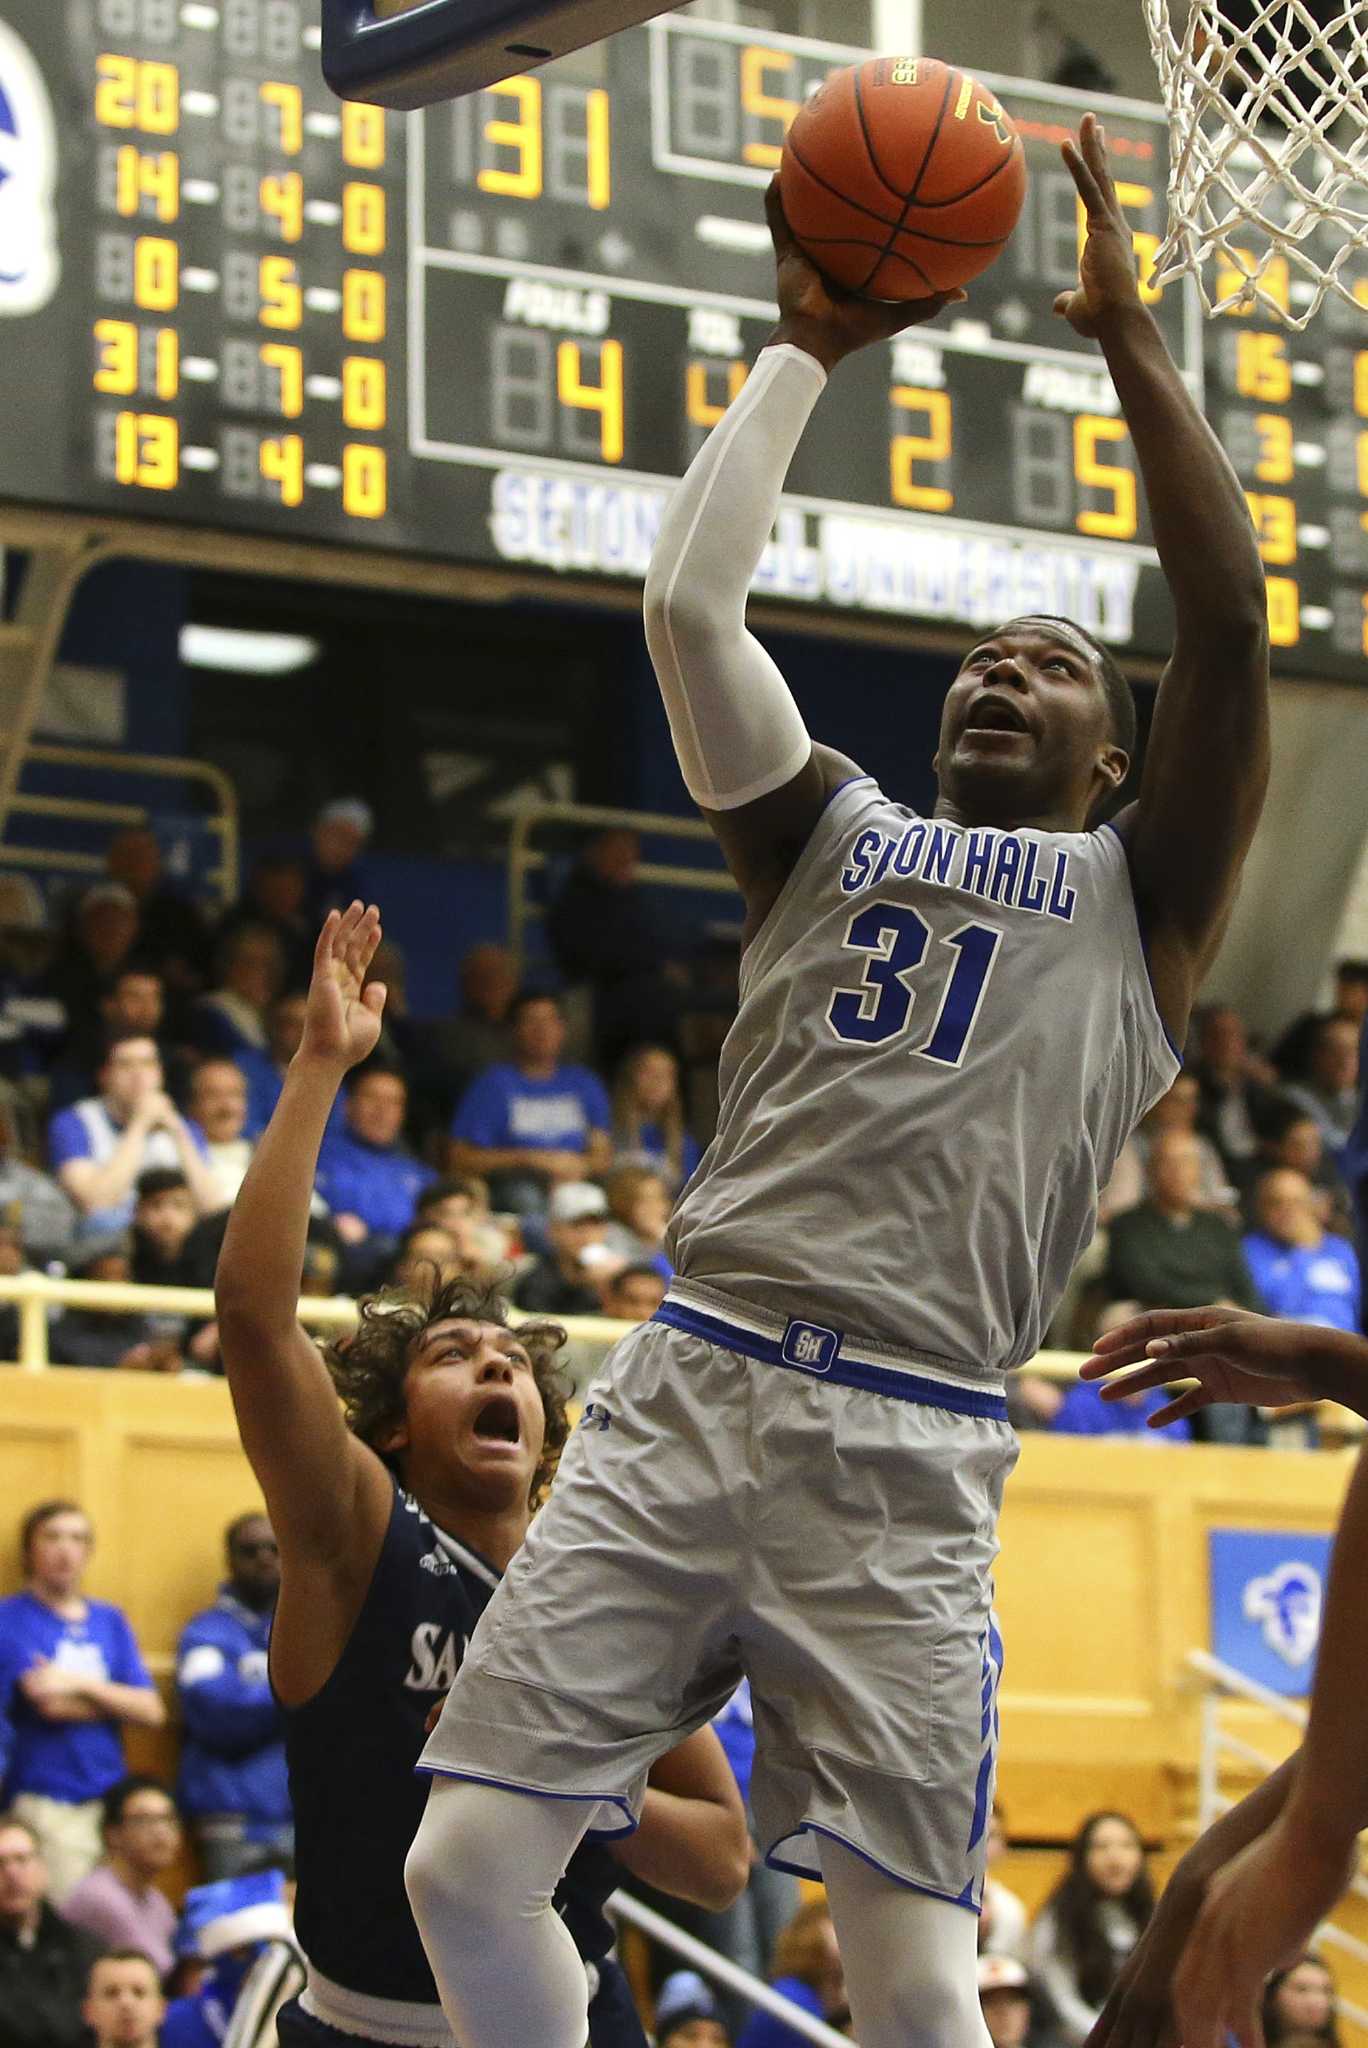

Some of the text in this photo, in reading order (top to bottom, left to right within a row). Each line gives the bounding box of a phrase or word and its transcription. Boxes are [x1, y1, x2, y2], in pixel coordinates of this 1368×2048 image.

[96, 54, 385, 169] 20 7 0
[476, 75, 610, 210] 31
[116, 144, 385, 255] 14 4 0
[135, 236, 385, 342] 0 5 0
[94, 319, 386, 430] 31 7 0
[556, 340, 624, 463] 4
[115, 411, 386, 518] 13 4 0
[890, 386, 954, 511] 2
[1073, 414, 1137, 538] 5
[1255, 413, 1294, 483] 3
[957, 832, 1078, 923] HALL
[824, 900, 1004, 1068] 31
